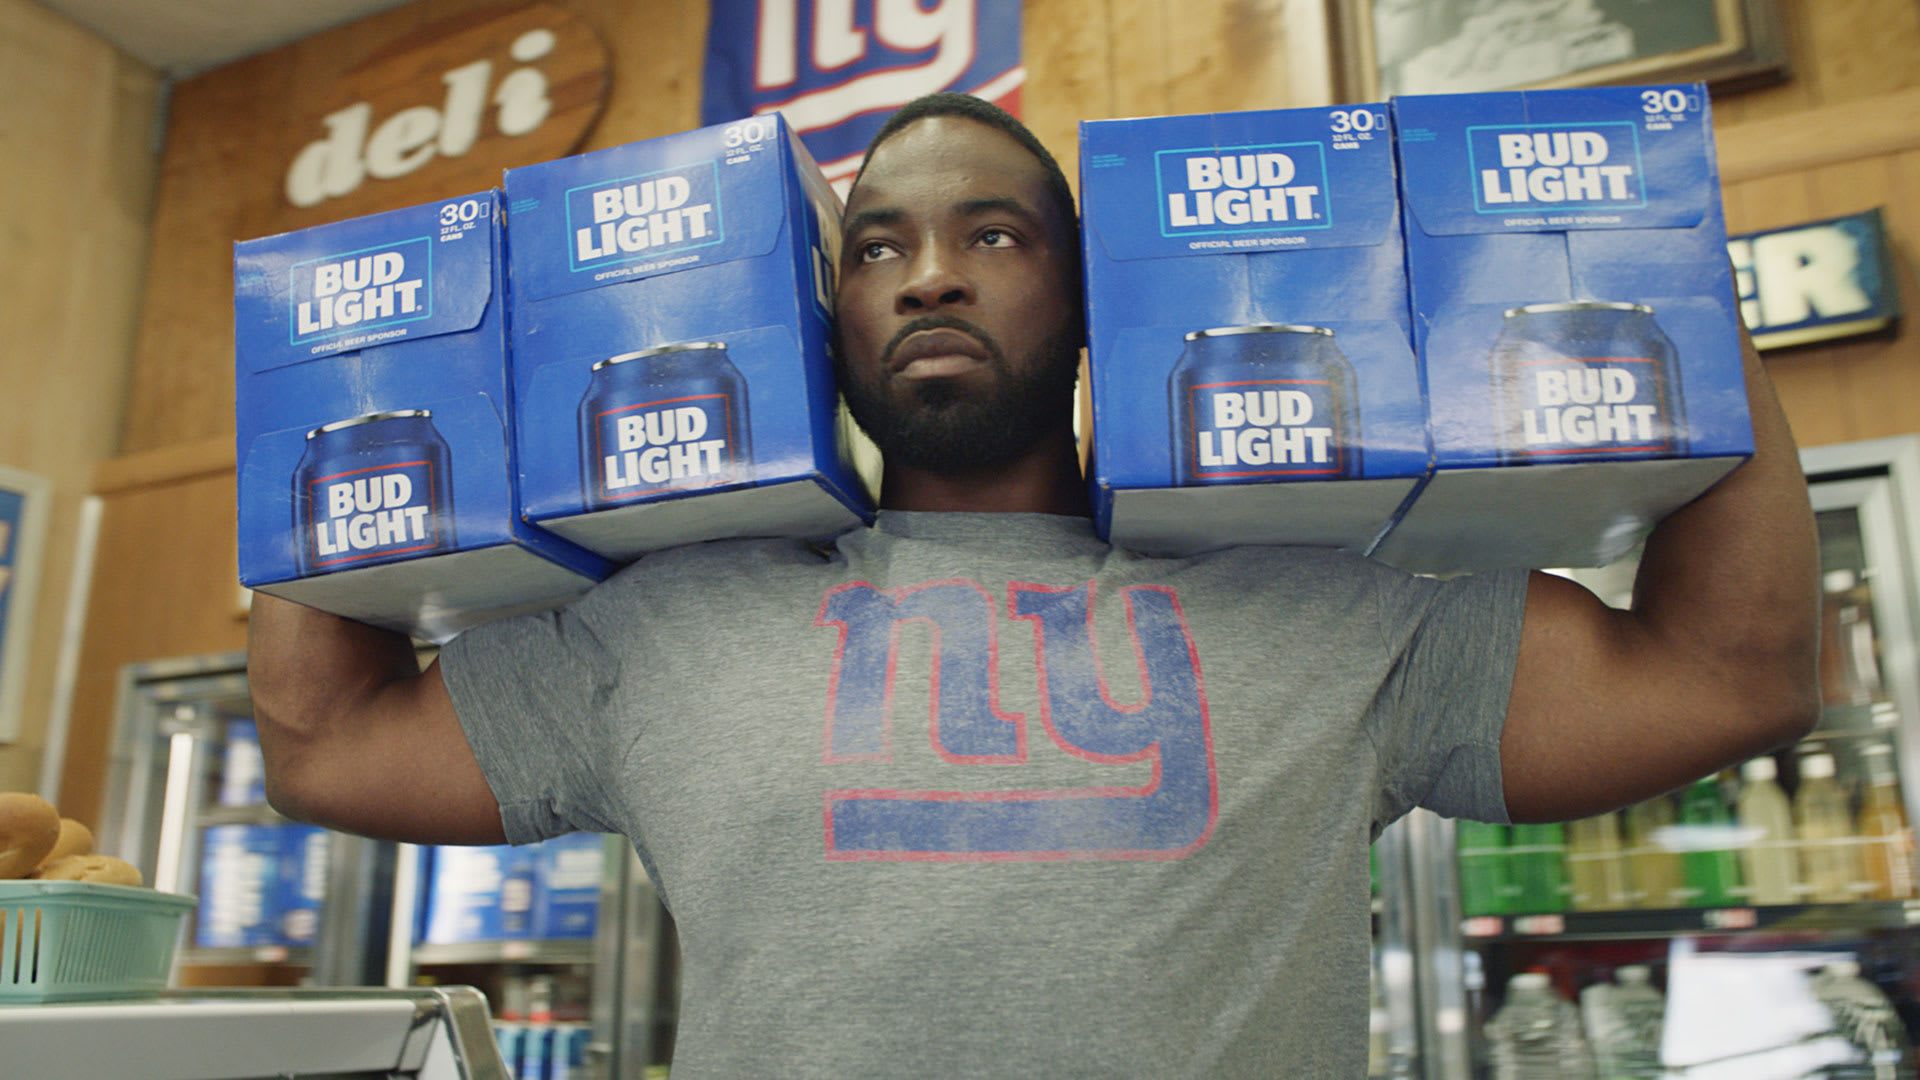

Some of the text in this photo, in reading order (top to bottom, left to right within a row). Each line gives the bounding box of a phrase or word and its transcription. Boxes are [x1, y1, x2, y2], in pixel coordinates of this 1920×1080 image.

[285, 29, 555, 207] deli
[1329, 109, 1374, 133] 30
[1641, 89, 1687, 114] 30
[723, 122, 764, 148] 30
[1498, 131, 1609, 168] BUD
[1186, 153, 1296, 190] BUD
[1481, 165, 1634, 204] LIGHT
[440, 199, 479, 226] 30
[593, 175, 691, 224] BUD
[1168, 185, 1320, 227] LIGHT
[576, 203, 713, 262] LIGHT
[314, 251, 405, 298] BUD
[297, 278, 423, 336] LIGHT
[1536, 368, 1637, 407] BUD
[617, 406, 708, 451] BUD
[1213, 390, 1314, 429] BUD
[1522, 404, 1657, 445] LIGHT
[604, 439, 726, 490] LIGHT
[1198, 427, 1334, 467] LIGHT
[328, 473, 412, 519] BUD
[316, 505, 430, 557] LIGHT
[814, 577, 1219, 863] ny
